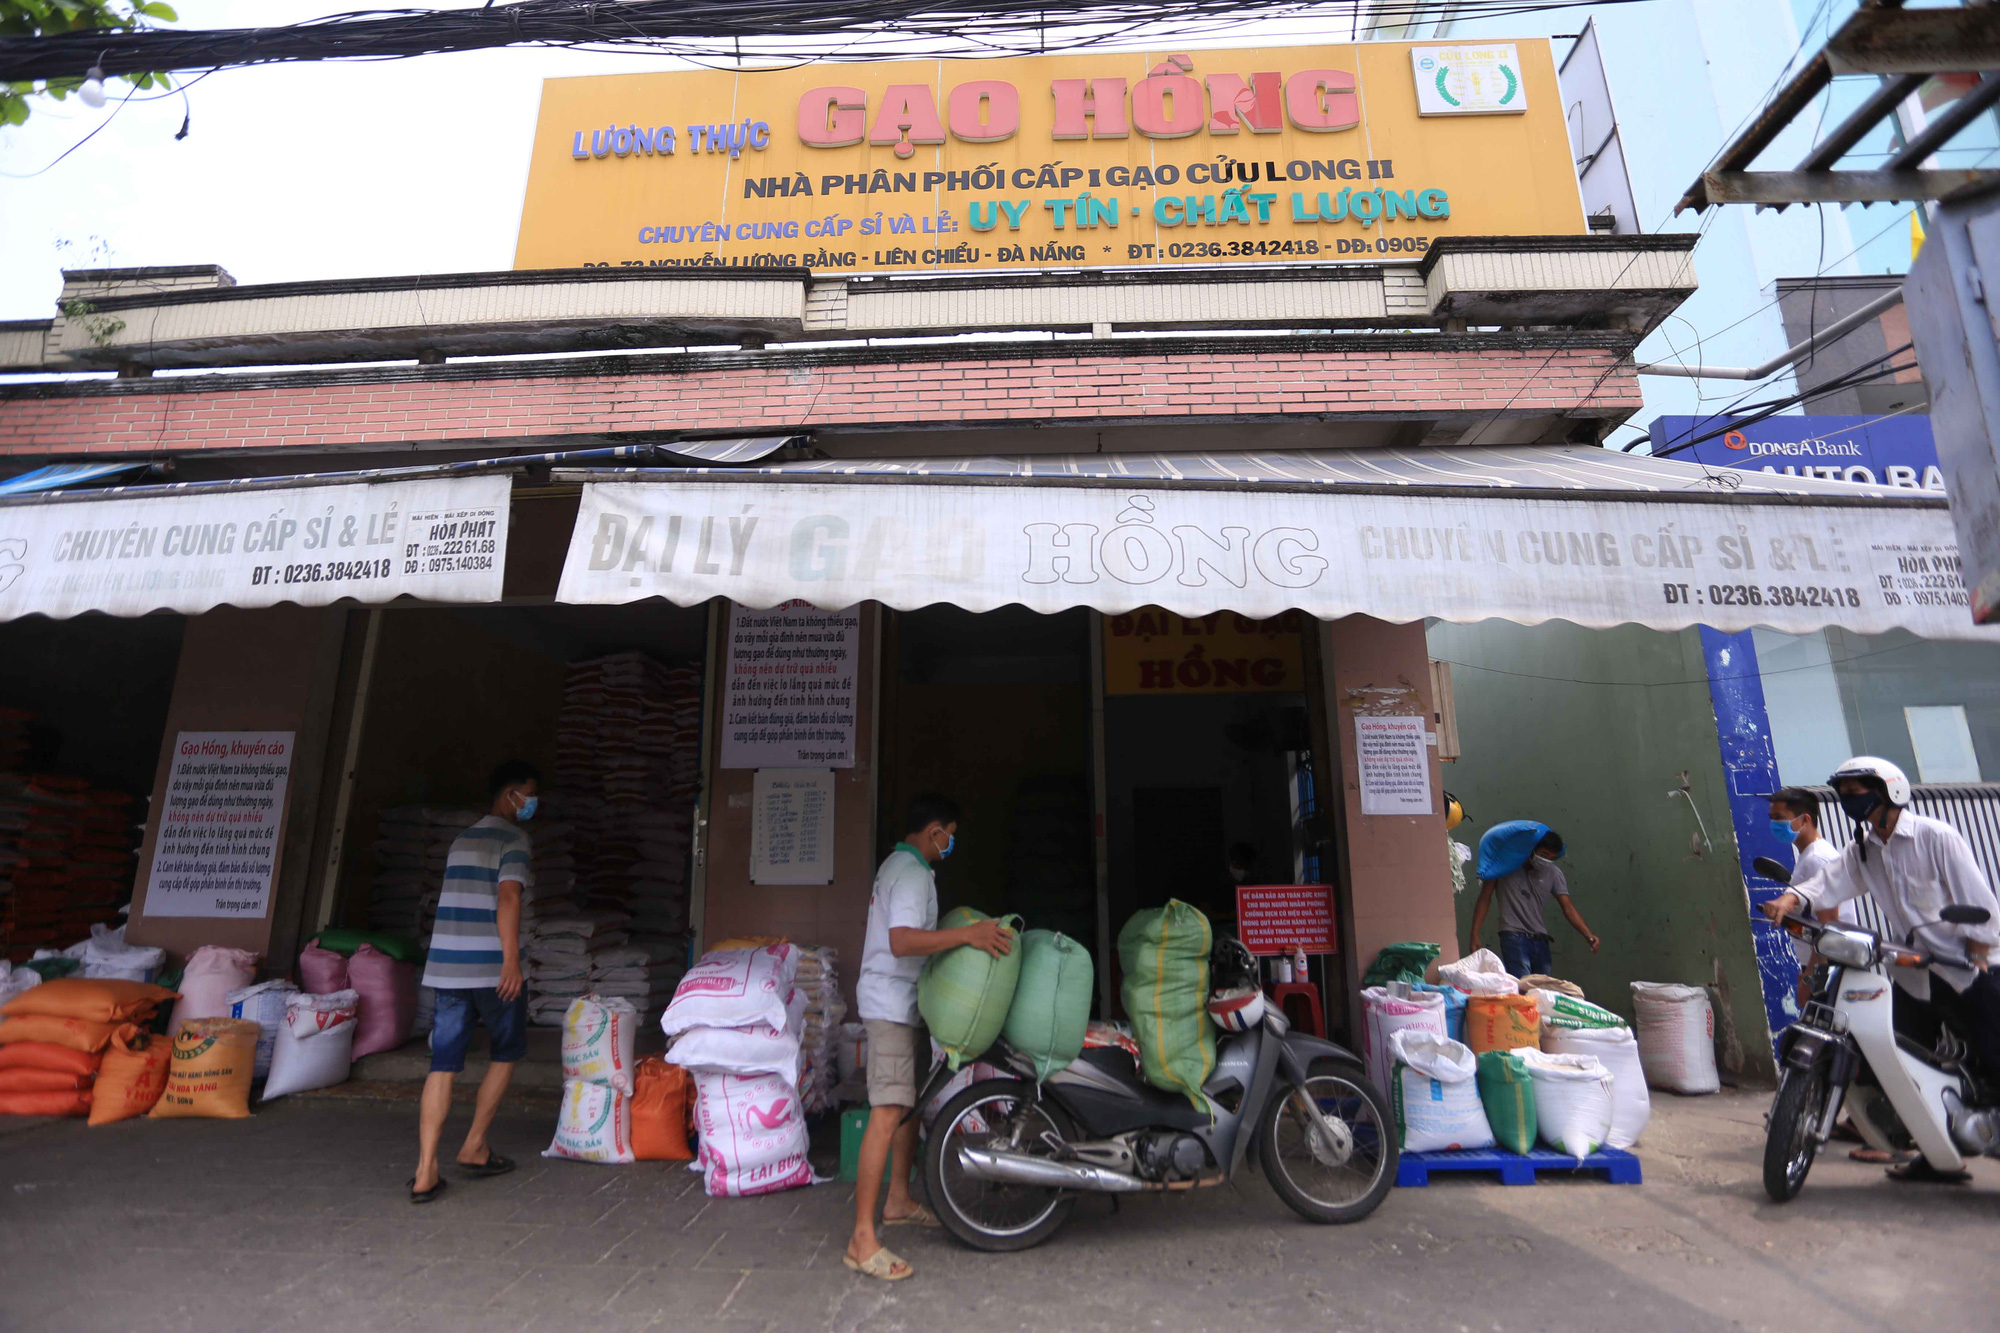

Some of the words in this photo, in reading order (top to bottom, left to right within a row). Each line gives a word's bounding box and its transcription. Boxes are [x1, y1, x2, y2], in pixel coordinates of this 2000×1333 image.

[796, 79, 1021, 160] GẠO
[1050, 54, 1361, 140] HỒNG
[572, 123, 677, 161] LƯƠNG
[687, 117, 771, 162] THỰC
[743, 172, 814, 199] NHÀ
[820, 168, 917, 196] PHÂN
[923, 161, 1006, 191] PHỐI
[1011, 160, 1084, 191] CẤP
[1105, 163, 1180, 191] GẠO
[1184, 154, 1261, 184] CỬU
[1264, 158, 1362, 183] LONG
[1366, 159, 1395, 180] II
[969, 200, 1033, 232] UY
[1044, 190, 1119, 231] TÍN
[1153, 184, 1278, 229] CHẤT
[1290, 186, 1451, 230] LƯỢNG
[638, 221, 731, 244] CHUYÊN
[735, 220, 799, 241] CUNG
[804, 212, 854, 238] CẤP
[859, 211, 883, 236] SỈ
[888, 213, 917, 235] VÀ
[802, 247, 857, 269] BẰNG
[874, 247, 915, 266] LIÊN
[921, 241, 980, 264] CHIỂU
[997, 244, 1024, 264] ĐÀ
[1030, 240, 1086, 263] NẴNG
[1168, 239, 1321, 259] 0236.3842418
[1375, 237, 1431, 256] 0905
[1815, 440, 1863, 456] Bank
[1887, 464, 1948, 492] BA
[53, 521, 159, 563] CHUYÊN
[162, 521, 238, 557] CUNG
[243, 508, 297, 554] CẤP
[303, 505, 335, 549] SỈ
[339, 515, 359, 548] &
[365, 501, 398, 546] LẺ
[588, 511, 683, 587] ĐẠI
[693, 503, 759, 577] LÝ
[1021, 494, 1330, 590] HỒNG
[1517, 530, 1622, 568] CUNG
[1631, 522, 1703, 570] CẤP
[283, 558, 391, 584] 0236.3842418
[428, 556, 493, 573] 0975.140384
[1708, 584, 1861, 608] 0236.3842418
[1912, 591, 1969, 607] 0975.1403
[181, 741, 200, 759] Gạo
[230, 738, 266, 759] khuyến
[268, 740, 285, 755] cáo
